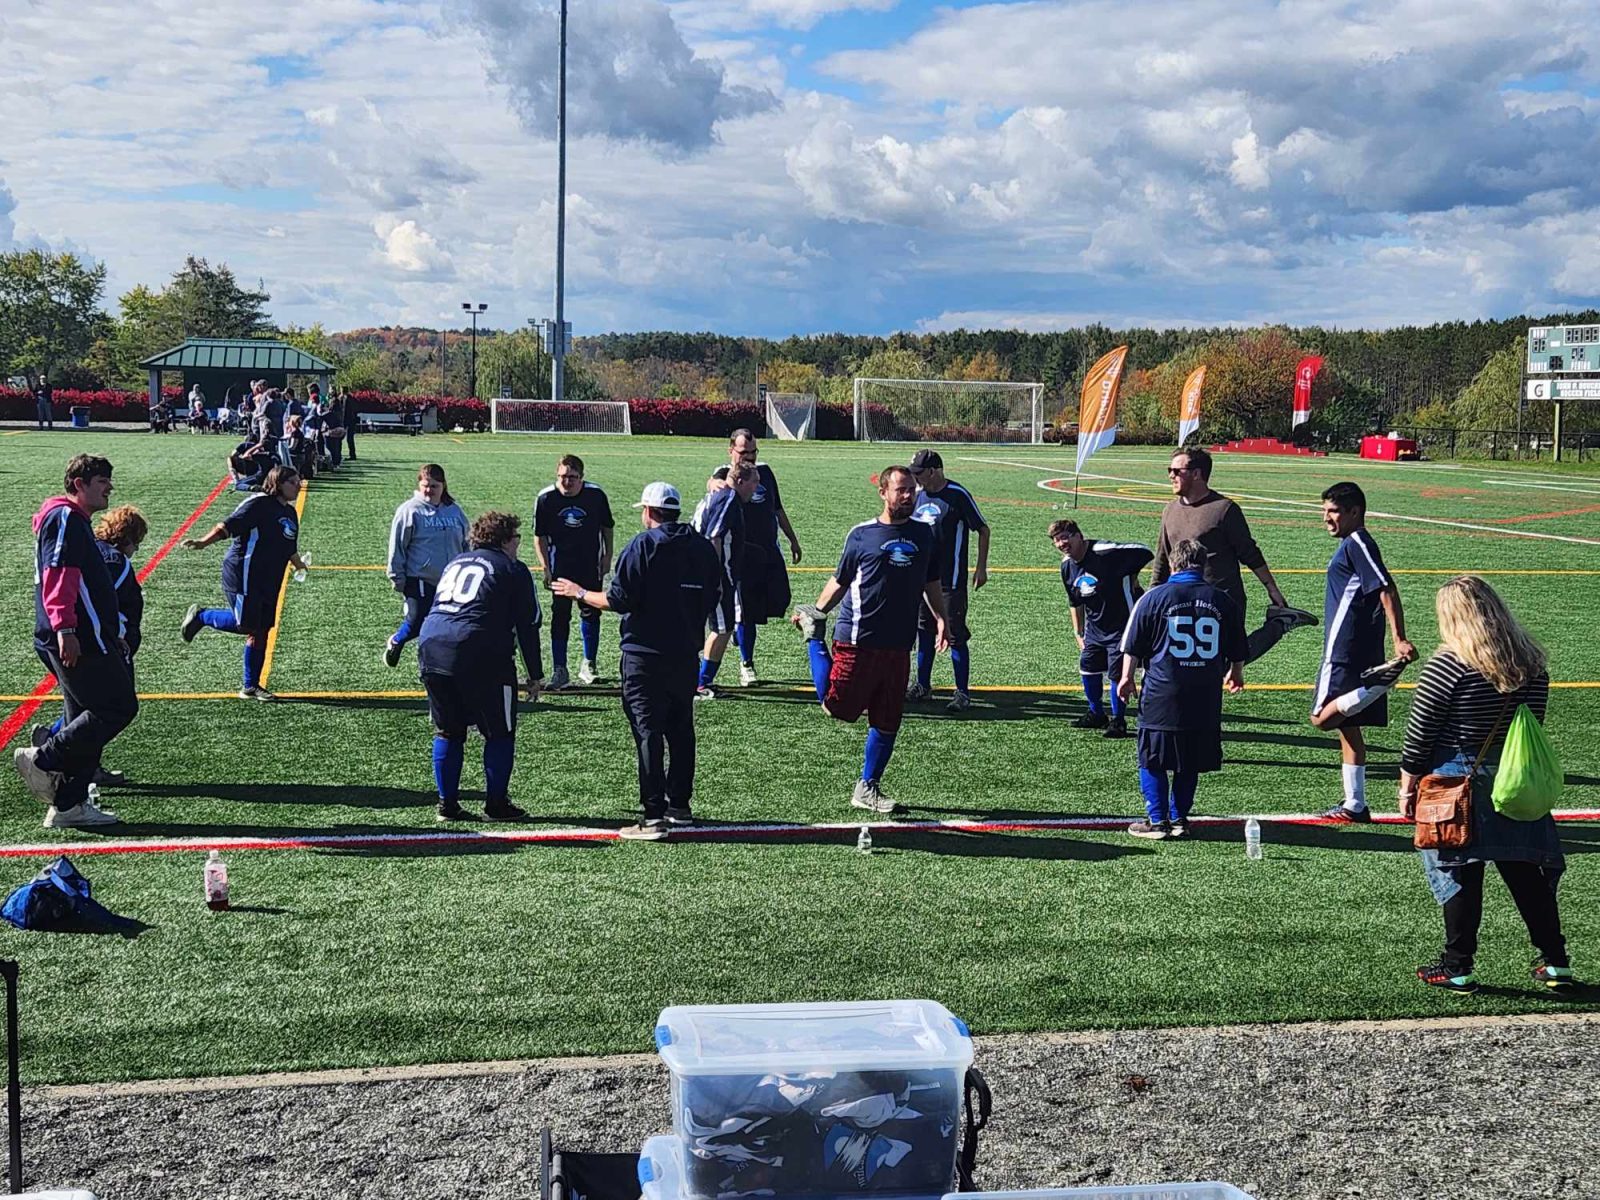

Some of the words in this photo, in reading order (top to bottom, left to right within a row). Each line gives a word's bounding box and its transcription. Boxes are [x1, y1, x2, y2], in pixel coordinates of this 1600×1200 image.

[1534, 383, 1544, 398] G
[436, 564, 485, 604] 40
[1168, 616, 1220, 659] 59
